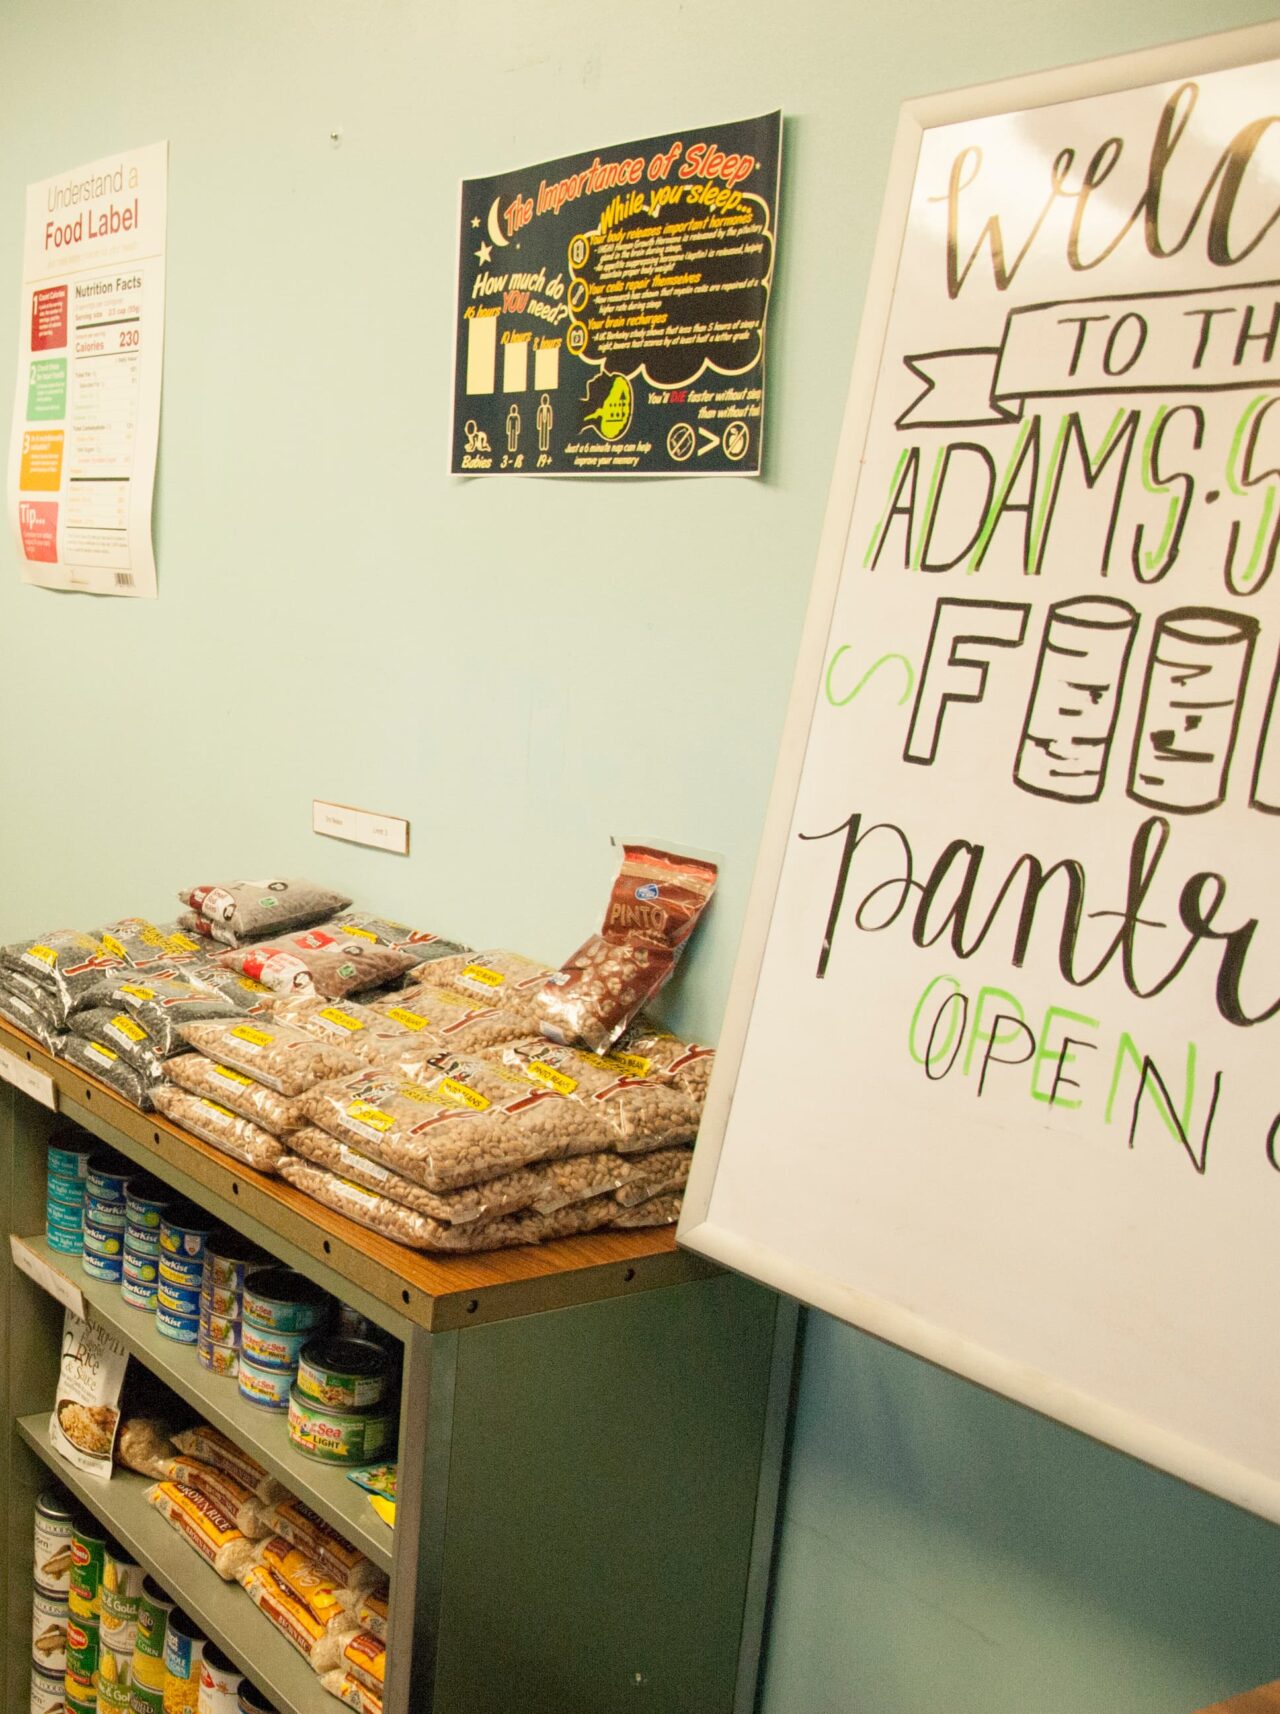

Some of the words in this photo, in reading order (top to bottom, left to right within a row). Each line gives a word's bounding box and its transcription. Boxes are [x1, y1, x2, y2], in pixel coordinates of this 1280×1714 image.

[47, 164, 124, 212] Understand
[128, 167, 139, 188] a
[504, 194, 533, 236] The
[536, 157, 645, 215] Importance
[647, 142, 683, 181] of
[679, 143, 755, 189] Sleep
[601, 189, 644, 234] While
[648, 184, 686, 214] you
[45, 212, 83, 250] Food
[88, 198, 139, 239] Label
[590, 234, 607, 246] Your
[607, 229, 626, 244] body
[626, 226, 662, 240] releases
[663, 216, 709, 237] important
[709, 213, 754, 229] hormones
[75, 281, 113, 298] Nutrition
[116, 276, 142, 292] Facts
[472, 271, 509, 299] How
[509, 267, 546, 292] much
[545, 273, 565, 299] do
[589, 283, 606, 295] Your
[606, 280, 624, 293] cells
[625, 278, 650, 292] repair
[652, 272, 702, 287] themselves
[464, 306, 477, 319] 16
[477, 304, 501, 319] hours
[502, 290, 531, 314] YOU
[527, 299, 569, 325] need?
[588, 318, 605, 330] Your
[605, 315, 625, 328] brain
[626, 312, 669, 330] recharges
[714, 321, 732, 331] hours
[76, 341, 105, 353] Calories
[119, 330, 140, 347] 230
[500, 331, 511, 344] 10
[511, 329, 532, 344] hours
[533, 337, 540, 351] 8
[541, 335, 562, 350] hours
[1057, 312, 1148, 377] TO
[648, 391, 669, 404] You'll
[670, 390, 687, 404] DIE
[688, 390, 714, 403] faster
[715, 388, 745, 401] without
[698, 405, 716, 419] than
[718, 405, 747, 418] without
[589, 443, 611, 452] minute
[611, 444, 624, 454] nap
[624, 444, 636, 452] can
[637, 441, 652, 453] help
[461, 454, 492, 469] Babies
[536, 455, 553, 469] 19+
[574, 457, 597, 467] improve
[597, 457, 612, 467] your
[612, 456, 640, 467] memory
[610, 903, 669, 931] PINTO
[909, 974, 1223, 1176] OPEN
[127, 1226, 158, 1242] StarKist
[318, 1423, 342, 1438] Sea
[313, 1435, 340, 1449] LIGHT
[207, 1505, 232, 1532] RICE
